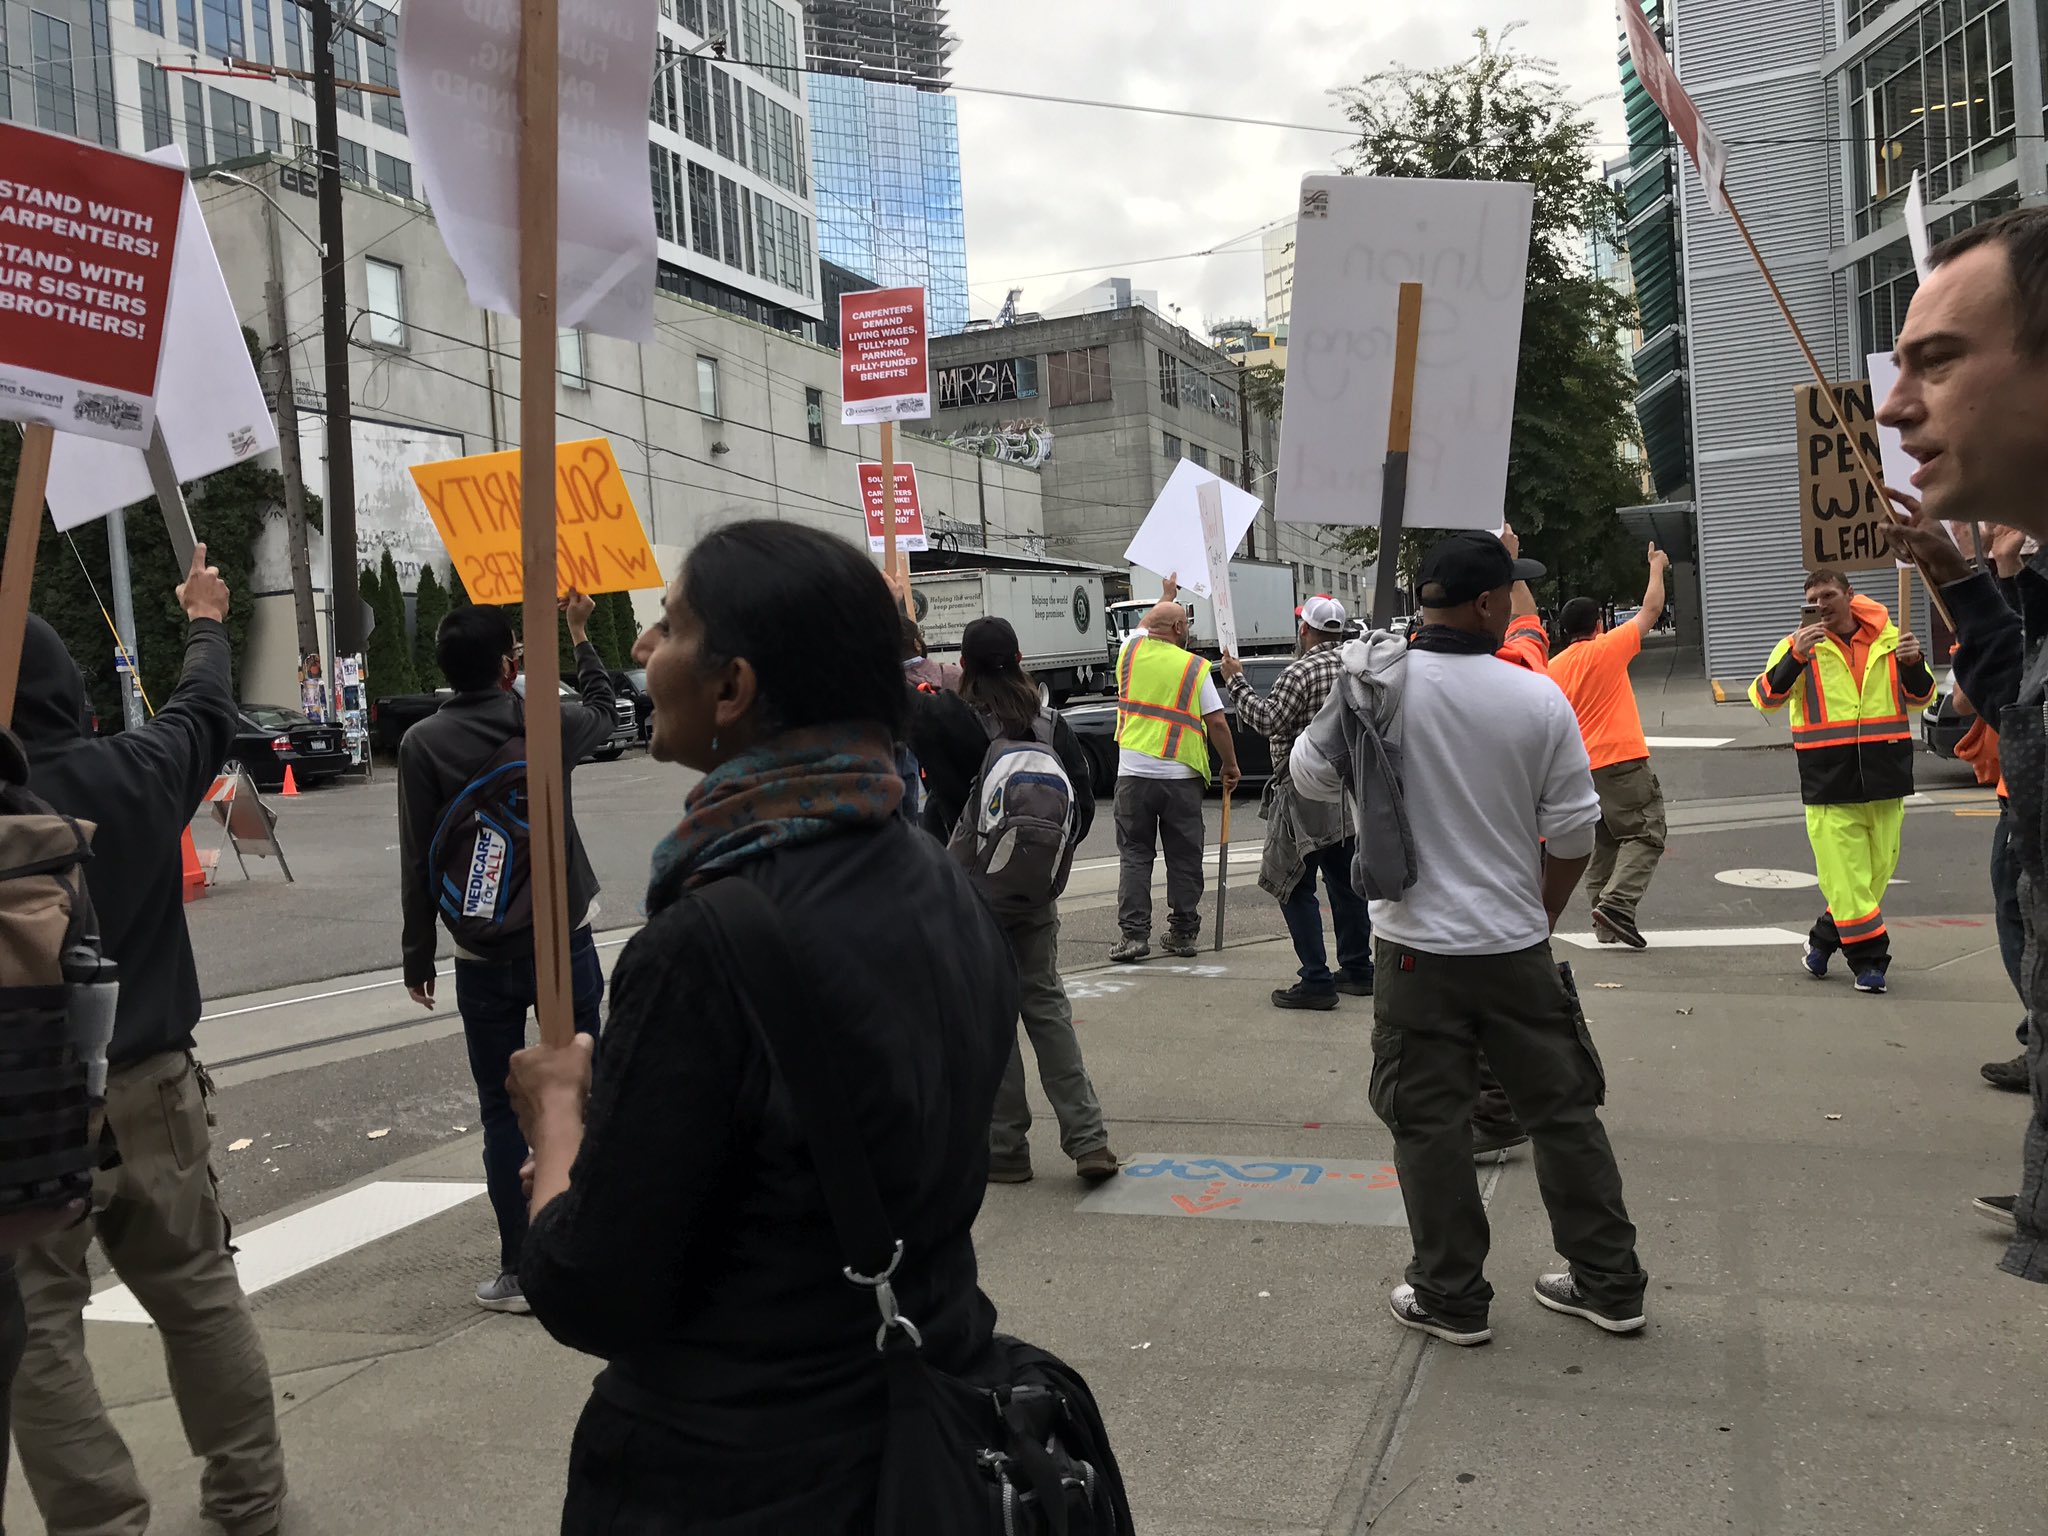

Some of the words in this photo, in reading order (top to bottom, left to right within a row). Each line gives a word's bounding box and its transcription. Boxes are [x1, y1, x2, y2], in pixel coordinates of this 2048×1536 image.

[0, 179, 82, 214] STAND
[87, 200, 153, 233] WITH
[0, 206, 160, 259] ARPENTERS!
[79, 260, 145, 292] WITH
[0, 266, 33, 290] UR
[38, 275, 147, 316] SISTERS
[0, 291, 146, 340] BROTHERS!
[852, 304, 913, 321] CARPENTERS
[862, 316, 903, 329] DEMAND
[848, 329, 880, 342] LIVING
[881, 325, 918, 338] WAGES,
[858, 338, 910, 352] FULLY-PAID
[861, 348, 907, 361] PARKING,
[850, 356, 918, 373] FULLY-FUNDED
[860, 368, 908, 382] BENEFITS!
[19, 385, 64, 404] Sawant
[867, 489, 912, 497] CARTERS
[871, 509, 902, 517] UND
[903, 508, 915, 516] WE
[880, 516, 909, 525] SND!
[930, 596, 953, 604] Helping
[953, 594, 964, 602] the
[964, 592, 981, 600] world
[1031, 594, 1047, 606] Helping
[1048, 594, 1056, 605] the
[1056, 595, 1068, 605] world
[933, 603, 948, 611] keep
[1034, 609, 1045, 620] keep
[466, 830, 493, 913] MEDICARE
[485, 843, 503, 883] ALL!
[480, 882, 495, 906] for
